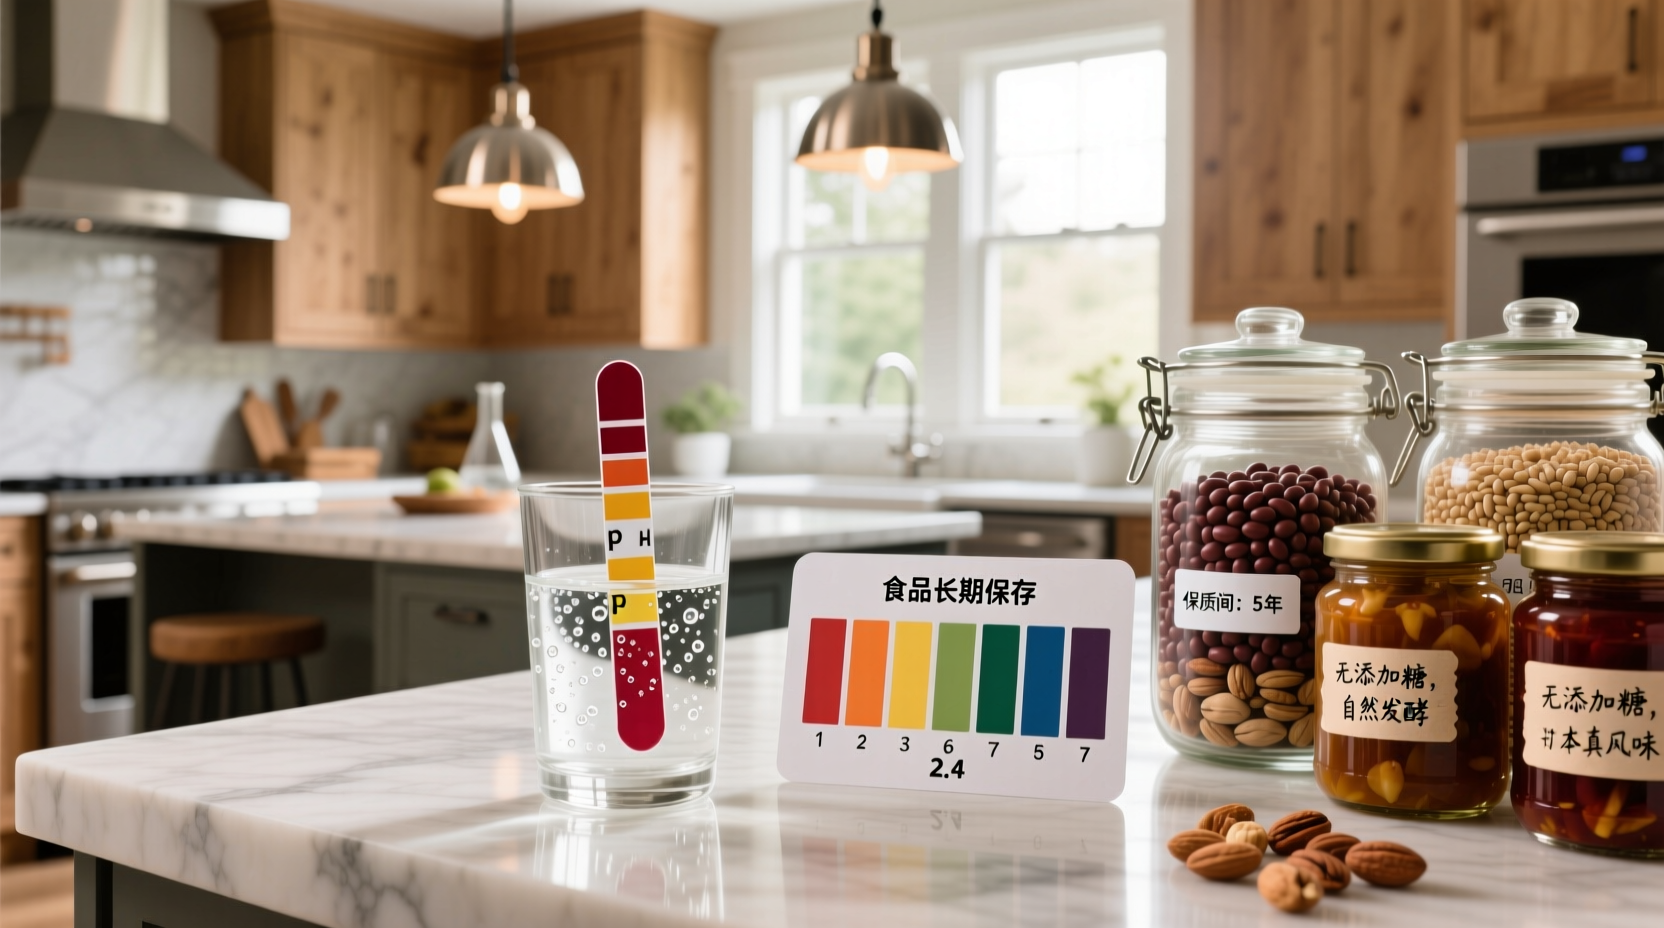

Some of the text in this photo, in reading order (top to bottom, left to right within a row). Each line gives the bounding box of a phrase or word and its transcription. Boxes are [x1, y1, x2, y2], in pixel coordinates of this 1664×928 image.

[883, 575, 1037, 606] 食品长期保存
[1343, 694, 1429, 727] 自然发酵
[815, 731, 1091, 763] 1 2 3 6 7 5 7
[929, 757, 966, 779] 2.4
